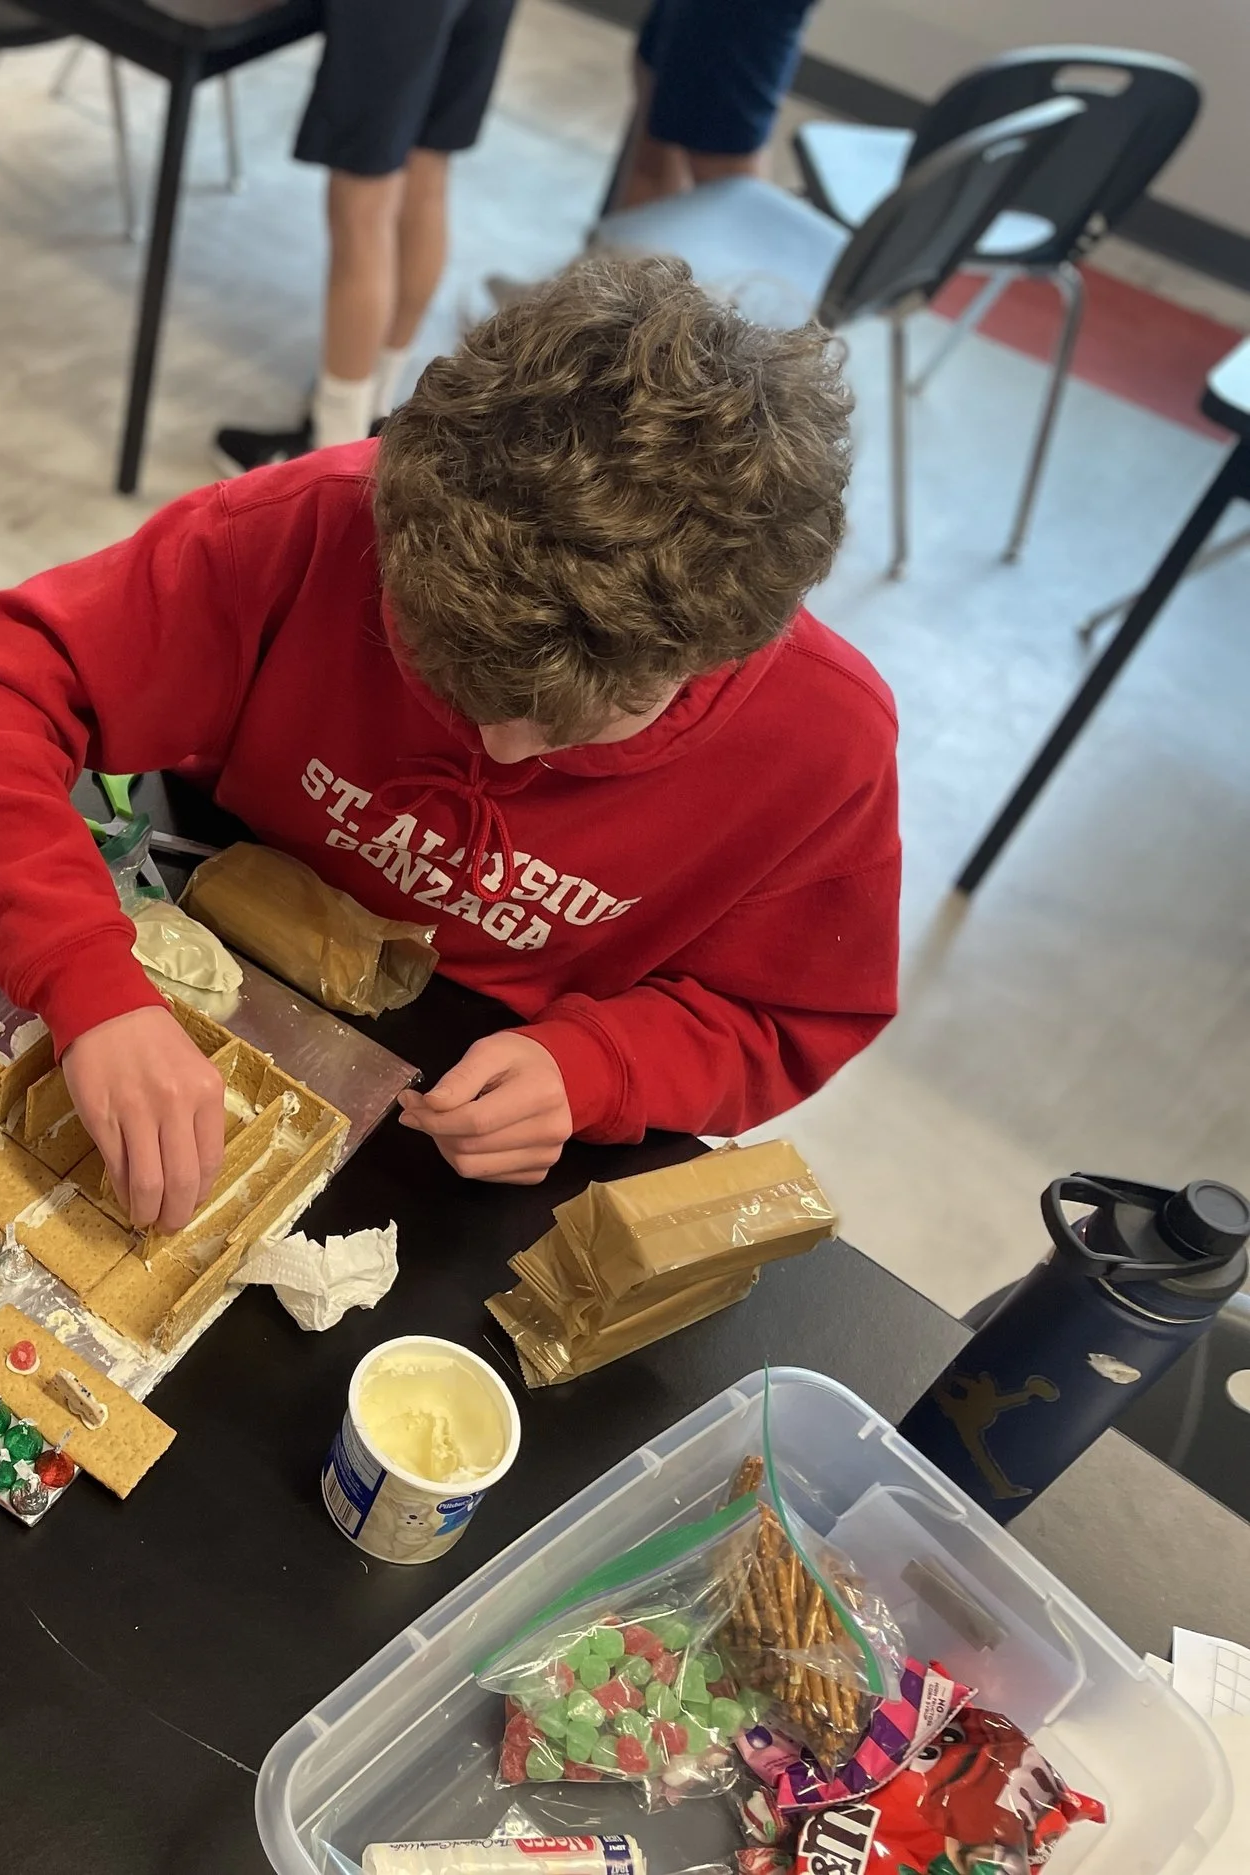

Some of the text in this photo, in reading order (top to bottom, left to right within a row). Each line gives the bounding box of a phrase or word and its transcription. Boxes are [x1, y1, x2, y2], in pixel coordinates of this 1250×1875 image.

[301, 758, 373, 832] ST.
[325, 828, 551, 950] GONZAGA
[936, 1698, 946, 1713] NO
[493, 1839, 510, 1847] The
